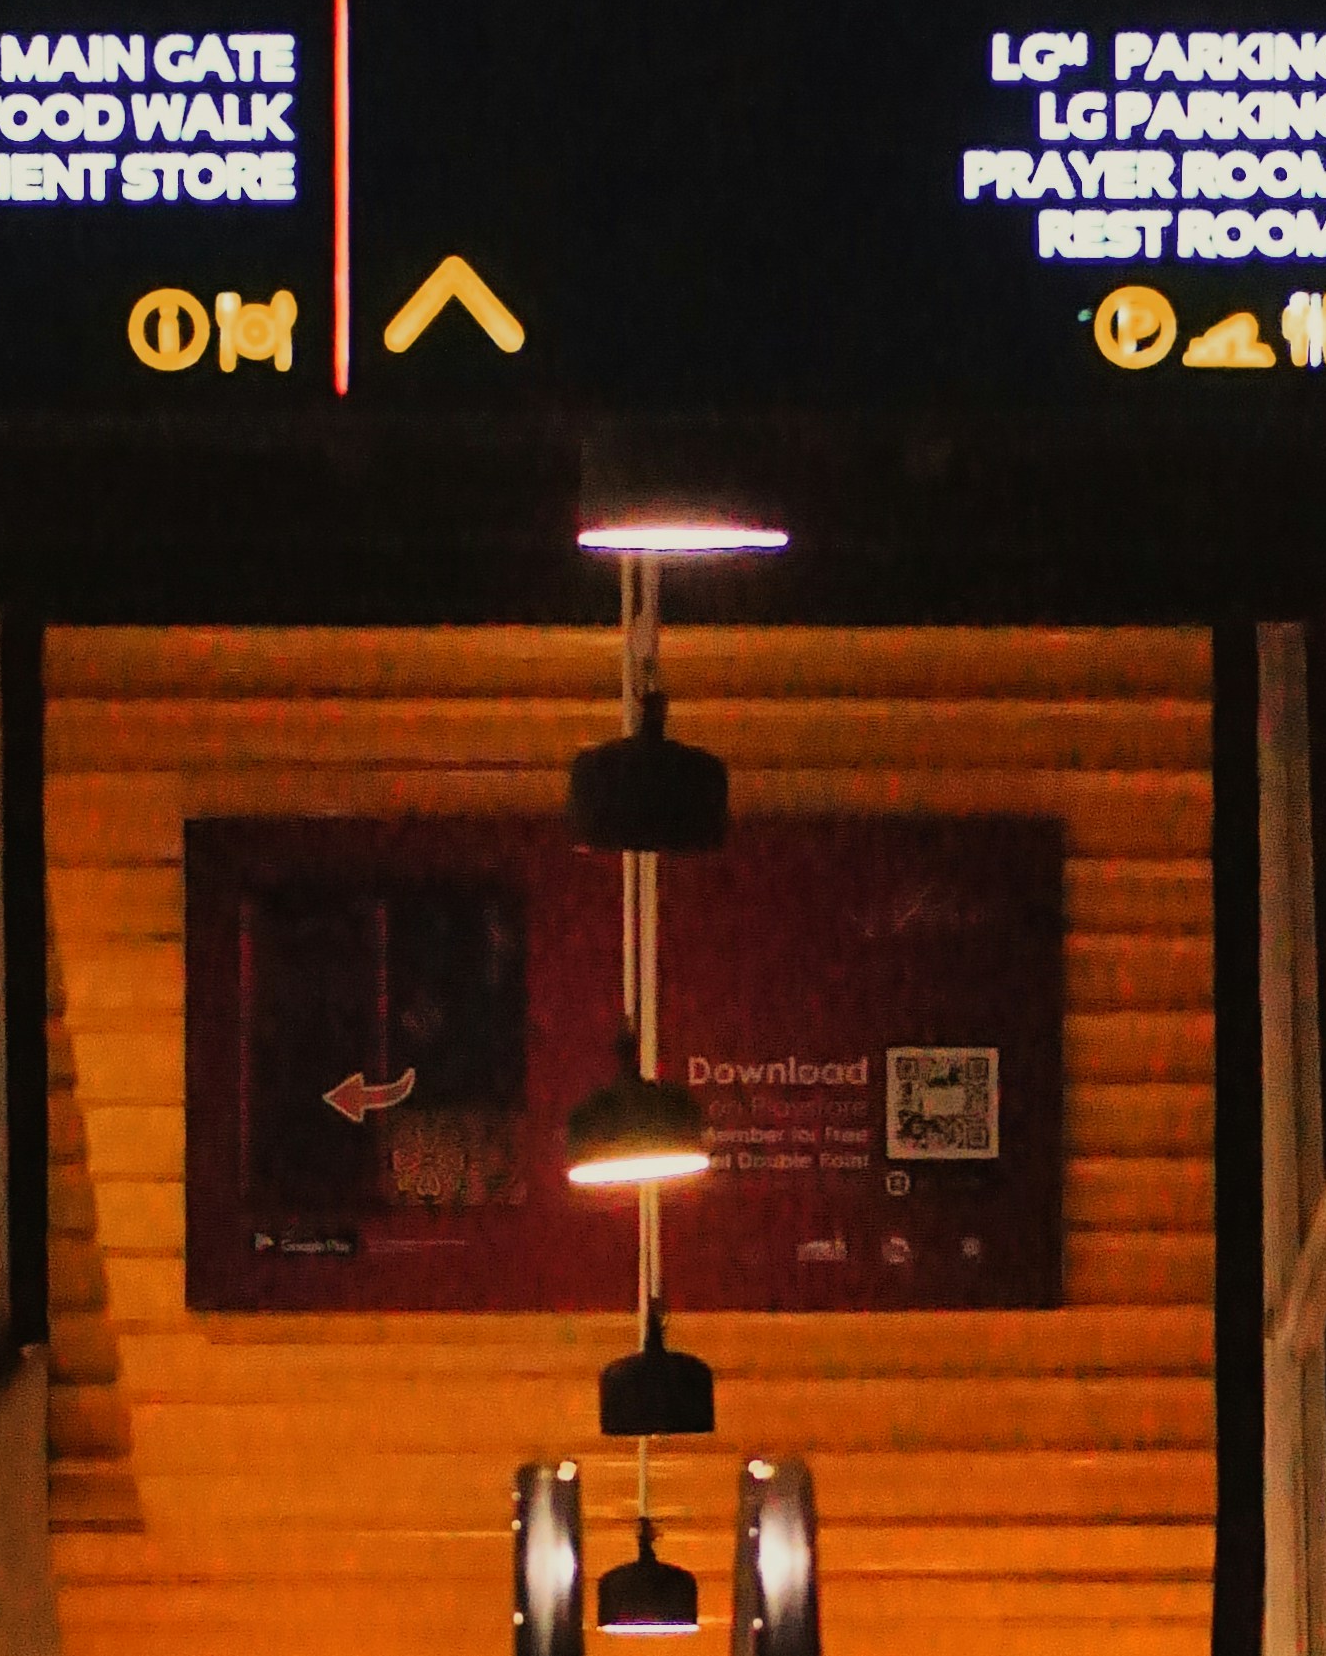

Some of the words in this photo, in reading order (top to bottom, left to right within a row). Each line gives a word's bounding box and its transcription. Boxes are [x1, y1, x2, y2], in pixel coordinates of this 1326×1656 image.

[0, 33, 146, 83] MAIN
[153, 33, 296, 83] GATE
[130, 92, 295, 142] WALK
[1039, 91, 1108, 141] LG
[120, 152, 297, 202] STORE
[963, 149, 1178, 200] PRAYER
[1038, 208, 1174, 259] REST
[688, 1056, 869, 1086] Download
